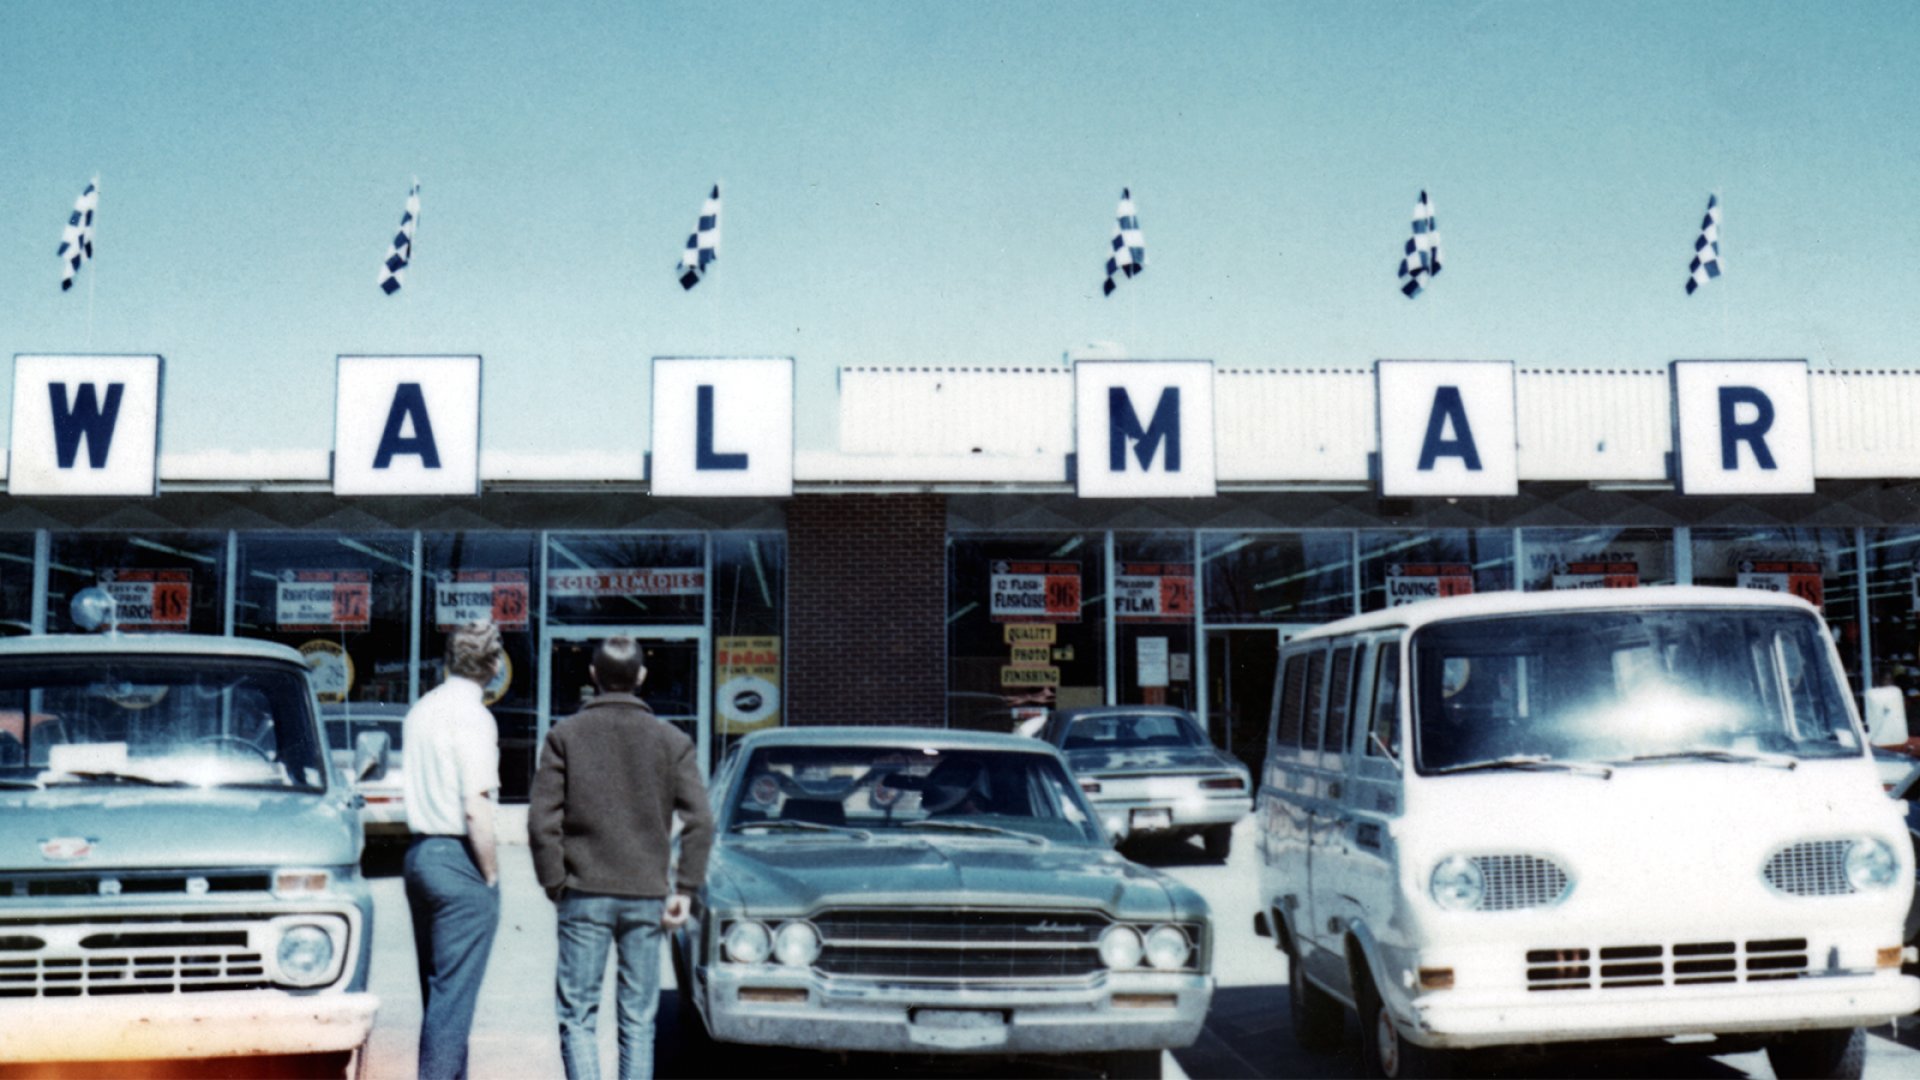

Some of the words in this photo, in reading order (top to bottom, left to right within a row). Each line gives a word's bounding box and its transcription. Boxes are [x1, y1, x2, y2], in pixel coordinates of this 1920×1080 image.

[554, 575, 600, 587] COLD
[609, 574, 697, 587] REMEDIES
[1390, 579, 1437, 596] LOVING
[1050, 582, 1075, 608] 96
[1115, 597, 1154, 612] FILM
[1009, 628, 1052, 641] QUALITY
[1014, 648, 1048, 660] PHOTO
